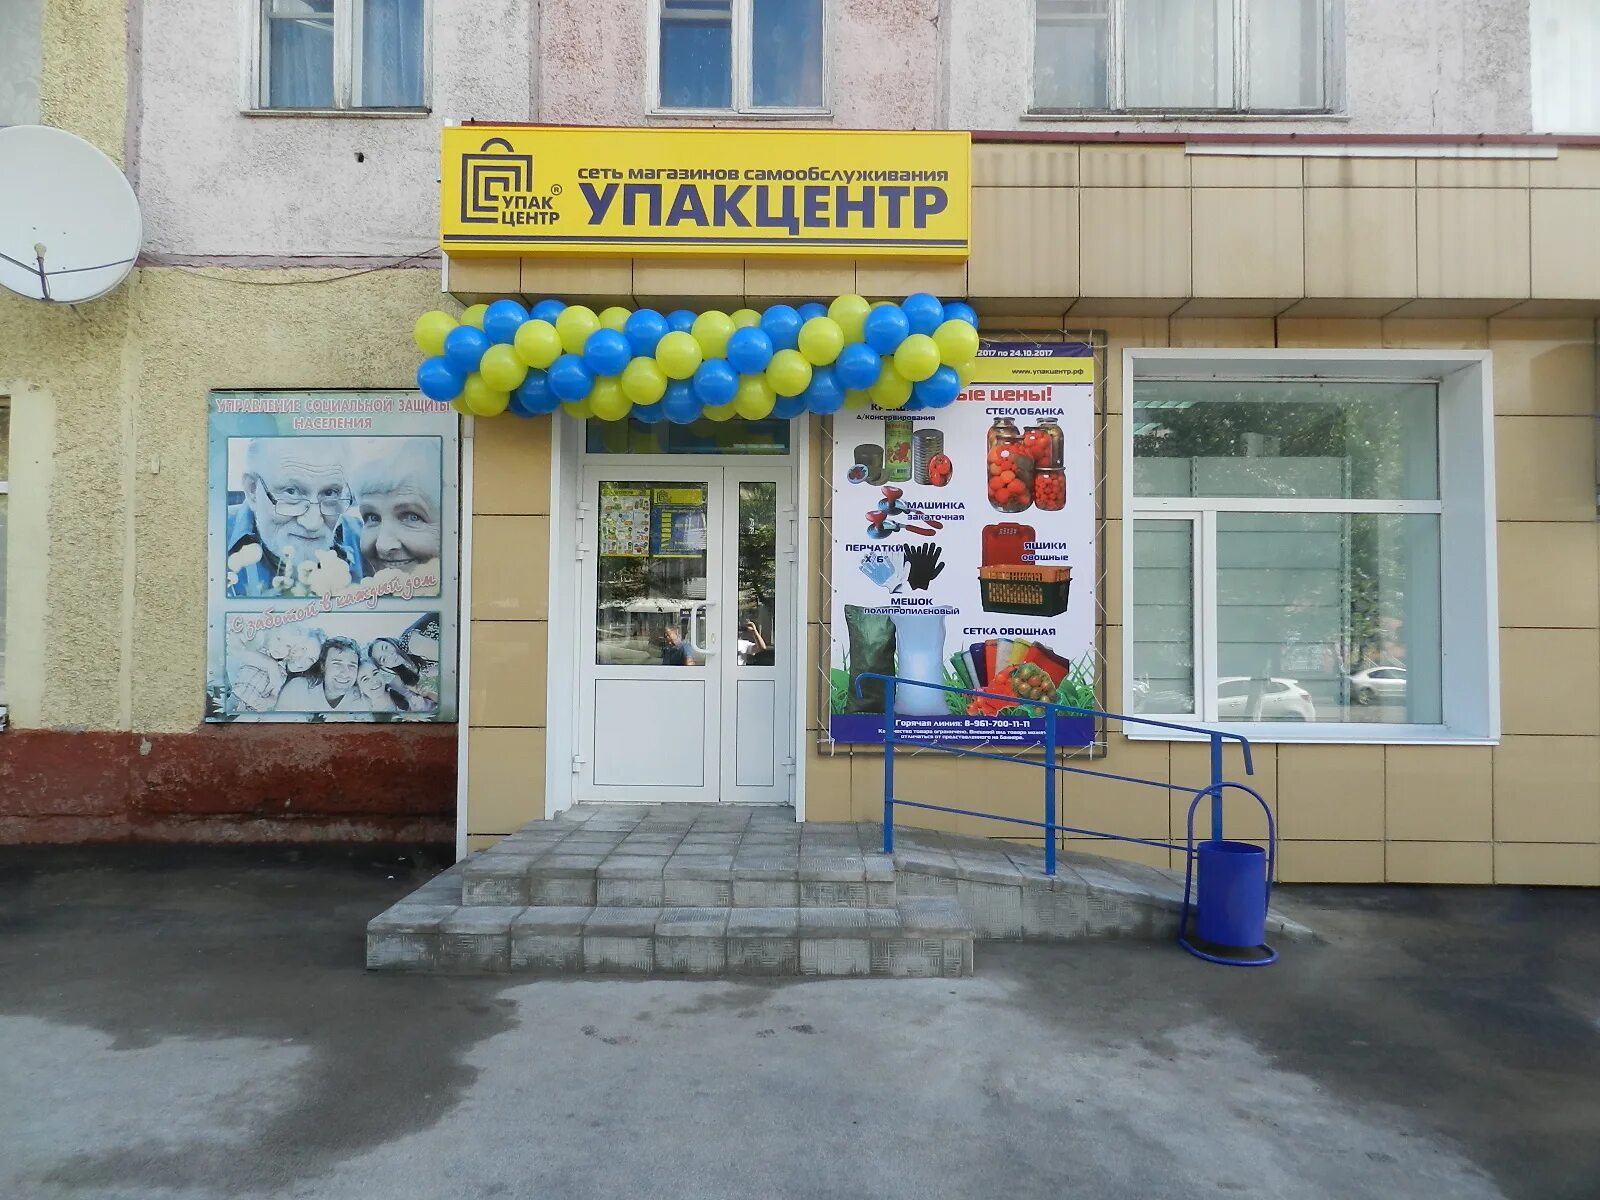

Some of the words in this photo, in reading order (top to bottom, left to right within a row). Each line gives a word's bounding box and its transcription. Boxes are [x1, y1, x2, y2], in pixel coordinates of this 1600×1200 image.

[577, 168, 624, 180] сеть
[628, 168, 740, 180] магазинов
[744, 167, 949, 184] самообслуживания
[502, 196, 554, 210] УПАК
[578, 183, 949, 236] УПАКЦЕНТР
[502, 212, 561, 227] ЦЕНТР
[1012, 368, 1084, 376] www.упакцентр.рф
[990, 386, 1052, 402] цены!
[216, 398, 300, 414] УПРАВЛЕНИЕ
[305, 397, 393, 414] СОЦИАЛЬНОЙ
[398, 399, 450, 414] ЗАЩИТЫ
[985, 407, 1065, 416] СТЕКЛОБАНКА
[293, 417, 373, 430] НАСЕЛЕНИЯ
[906, 501, 966, 510] МАШИНКА
[907, 513, 965, 521] закаточная
[845, 544, 904, 552] ПЕРЧАТКИ
[1024, 542, 1067, 550] ЯЩИКИ
[1021, 554, 1069, 562] овощные
[890, 597, 933, 606] МЕШОК
[231, 615, 244, 633] С
[243, 603, 320, 641] заботой
[319, 590, 333, 612] в
[335, 576, 403, 609] каждый
[402, 574, 437, 600] дом
[864, 607, 960, 615] ПОЛИПРОПИЛЕНОВЫЙ
[962, 627, 998, 635] СЕТКА
[999, 627, 1056, 636] ОВОЩНАЯ
[895, 719, 932, 728] Горячая
[964, 719, 1030, 728] 8-961-700-11-11
